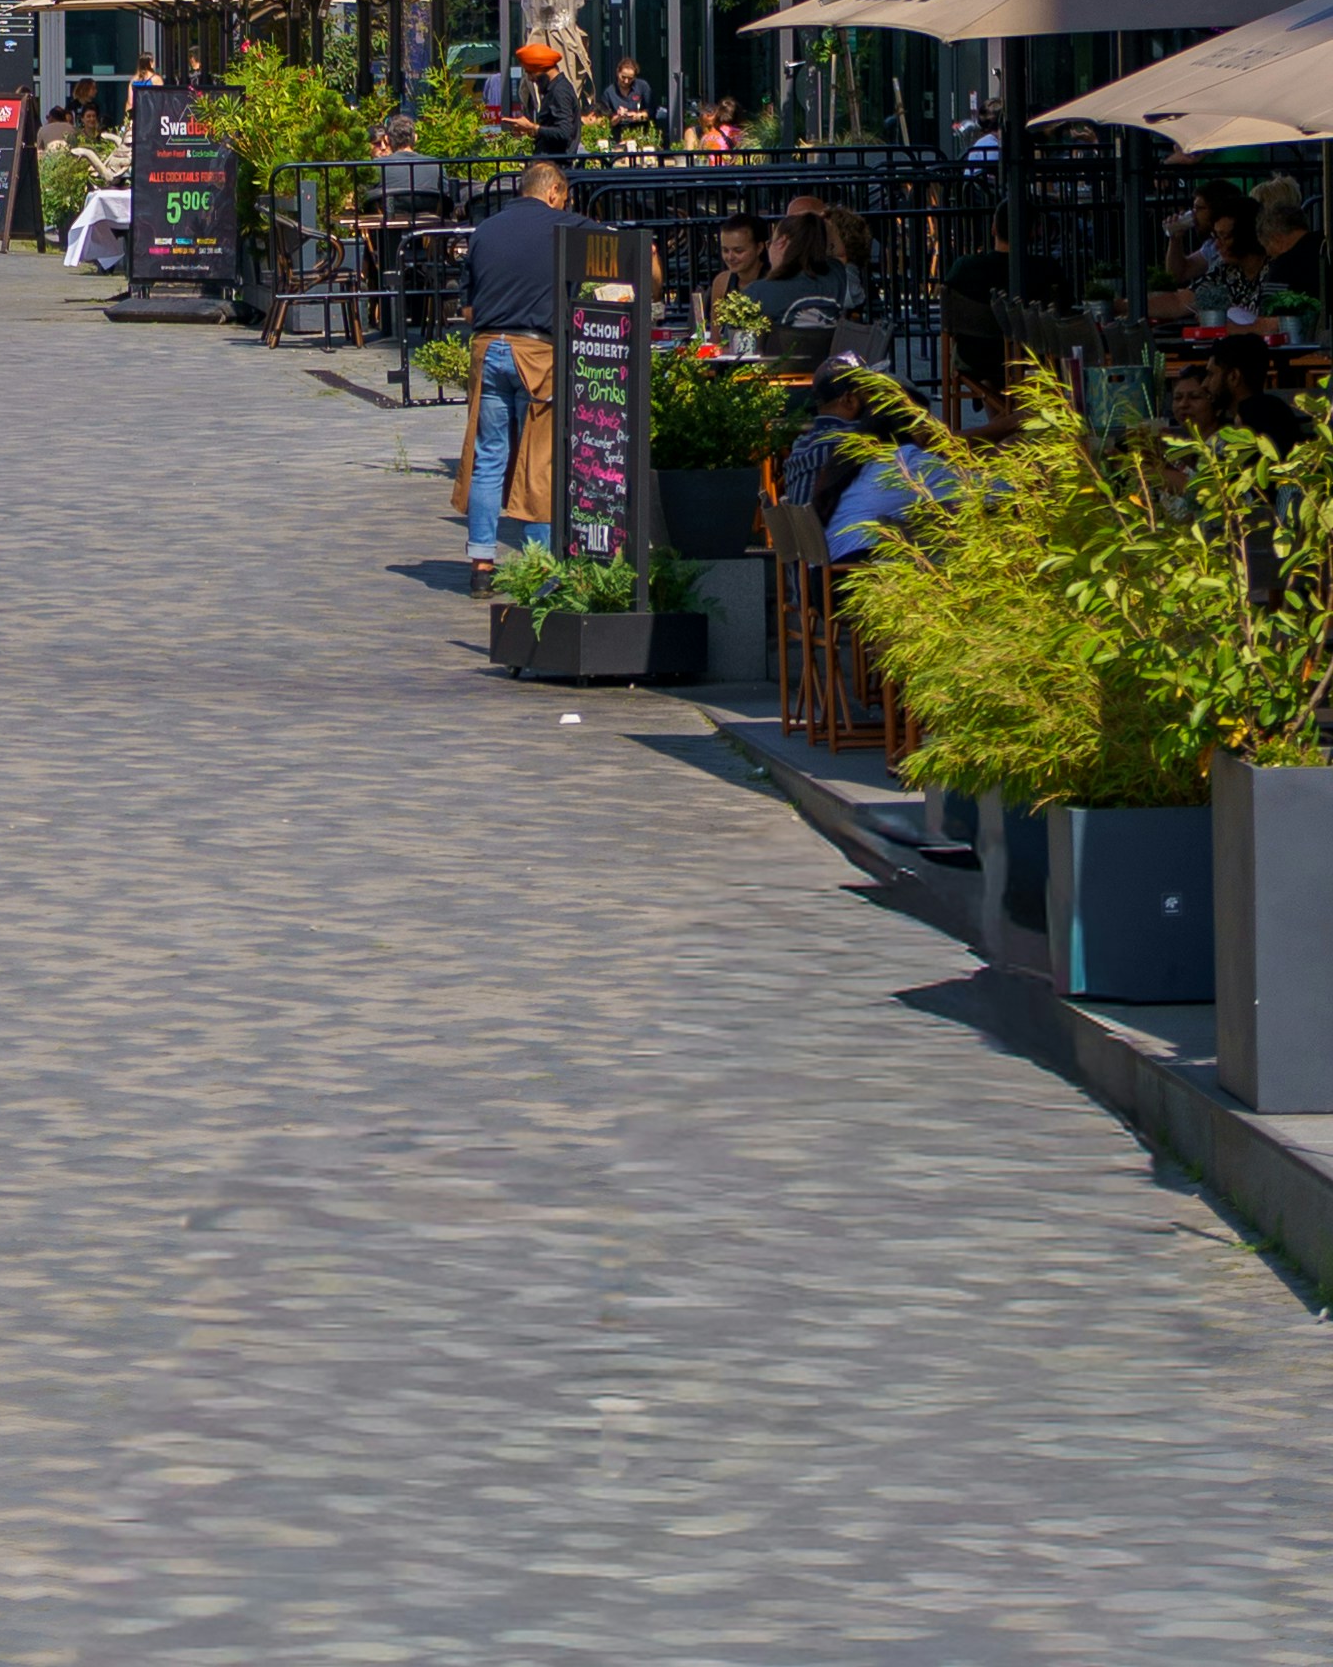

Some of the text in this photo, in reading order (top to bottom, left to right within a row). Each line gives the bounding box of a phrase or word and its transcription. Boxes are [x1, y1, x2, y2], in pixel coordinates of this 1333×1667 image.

[186, 149, 191, 158] &
[148, 171, 165, 182] ALLE
[166, 171, 199, 182] COCKTAILS
[586, 234, 619, 278] ALEX
[583, 322, 620, 340] SCHON
[572, 340, 630, 359] PROBIERT?
[575, 355, 619, 380] Summer
